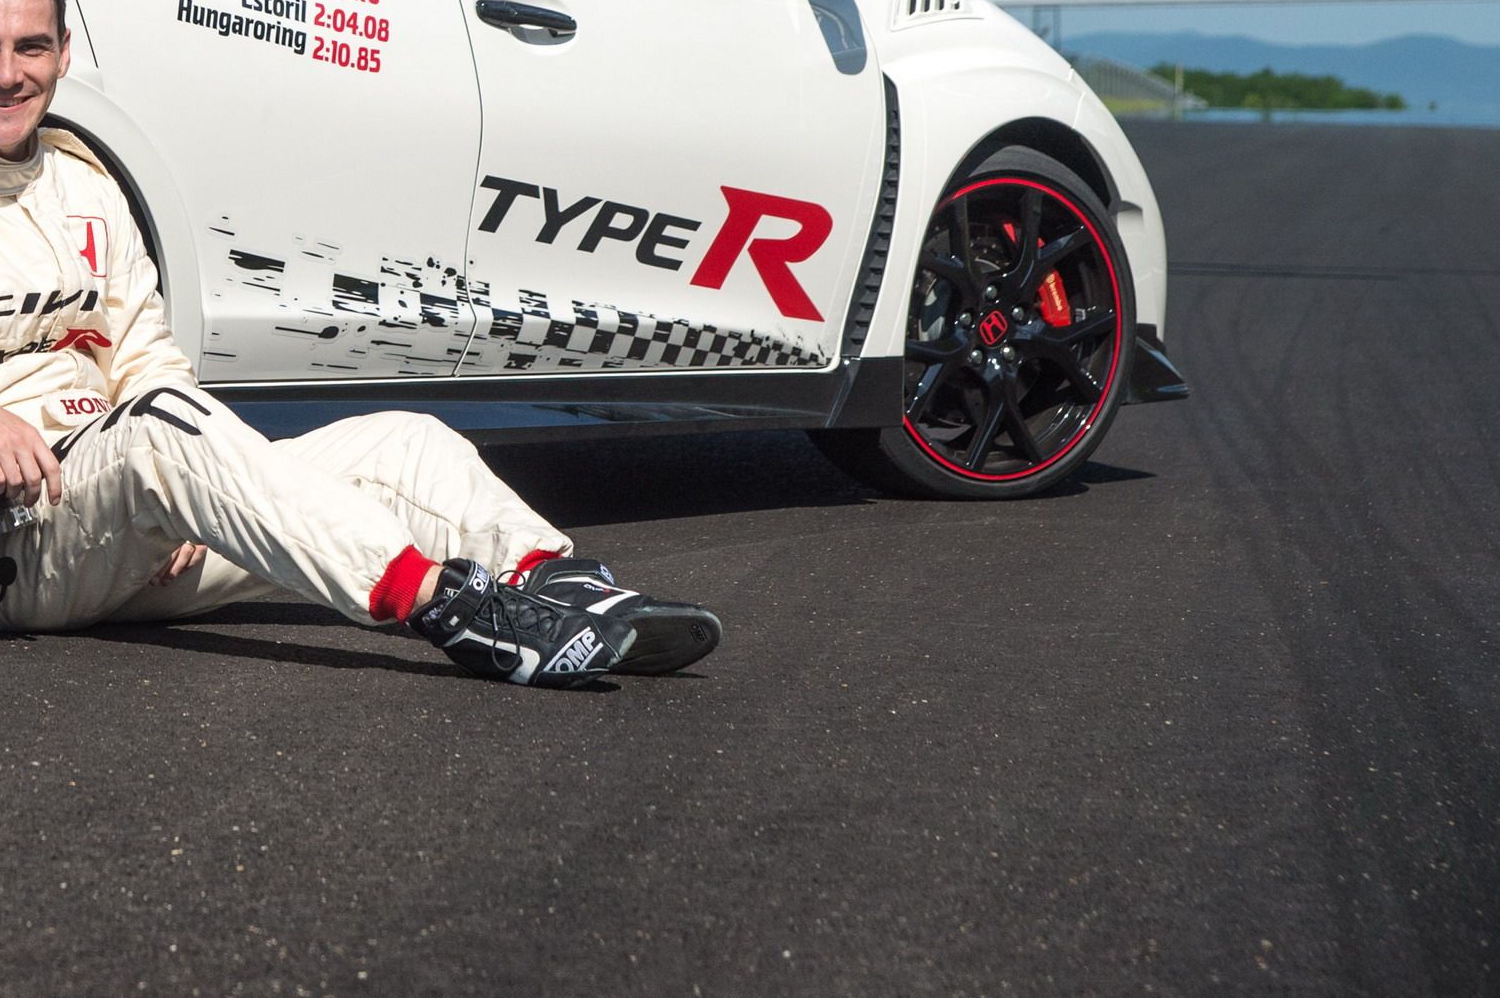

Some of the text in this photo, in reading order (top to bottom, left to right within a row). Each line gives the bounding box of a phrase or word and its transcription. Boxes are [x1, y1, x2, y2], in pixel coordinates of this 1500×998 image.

[314, 3, 390, 43] 2:04.08
[312, 36, 381, 74] 2:10.85
[478, 175, 834, 323] TYPE R
[60, 398, 112, 415] HON
[555, 630, 596, 672] OMP
